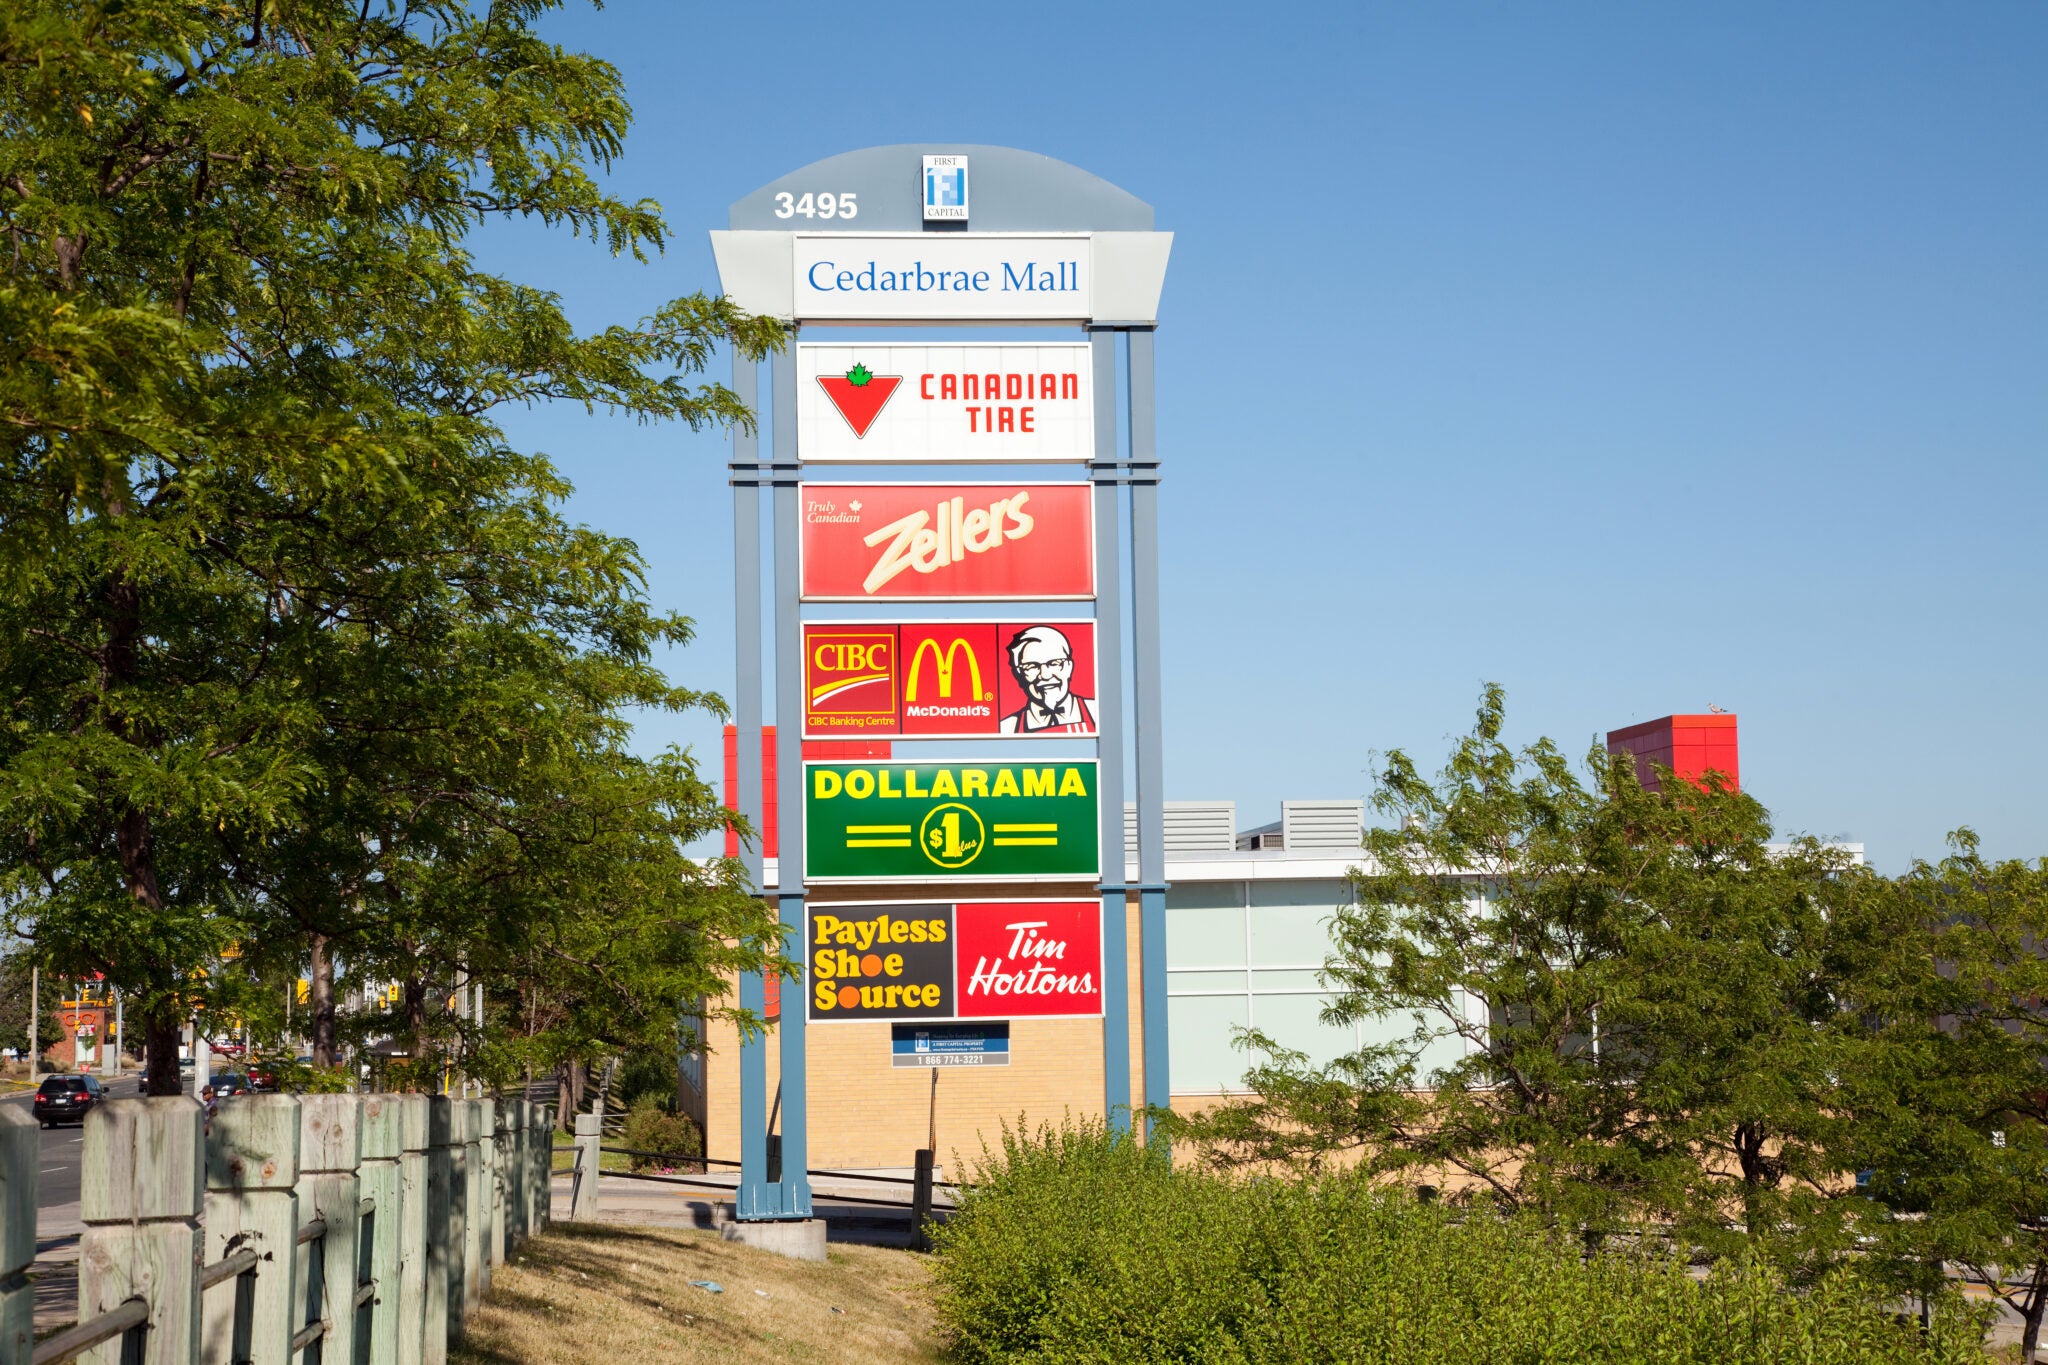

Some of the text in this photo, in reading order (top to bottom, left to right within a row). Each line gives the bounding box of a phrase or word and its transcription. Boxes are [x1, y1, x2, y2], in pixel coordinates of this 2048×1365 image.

[934, 157, 957, 166] FIRST
[774, 192, 858, 219] 3495
[927, 208, 965, 217] CAPITAL
[808, 262, 1080, 292] Cedarbrae Mall
[921, 374, 1079, 400] CANADIAN
[966, 407, 1035, 433] TIRE
[807, 512, 860, 524] Canadian
[808, 500, 836, 514] Truly
[863, 491, 1034, 595] Zellers
[814, 643, 887, 671] CIBC
[808, 717, 895, 727] CIBC Banking Centre
[906, 705, 990, 717] McDonald's
[814, 768, 1087, 799] DOLLARAMA
[929, 813, 963, 857] $1
[813, 914, 947, 950] Payless
[1005, 921, 1067, 960] Tim
[814, 949, 904, 979] Shoe
[967, 955, 1092, 996] Hortons
[814, 980, 941, 1010] Source
[918, 1055, 983, 1065] 1 866 774-3221
